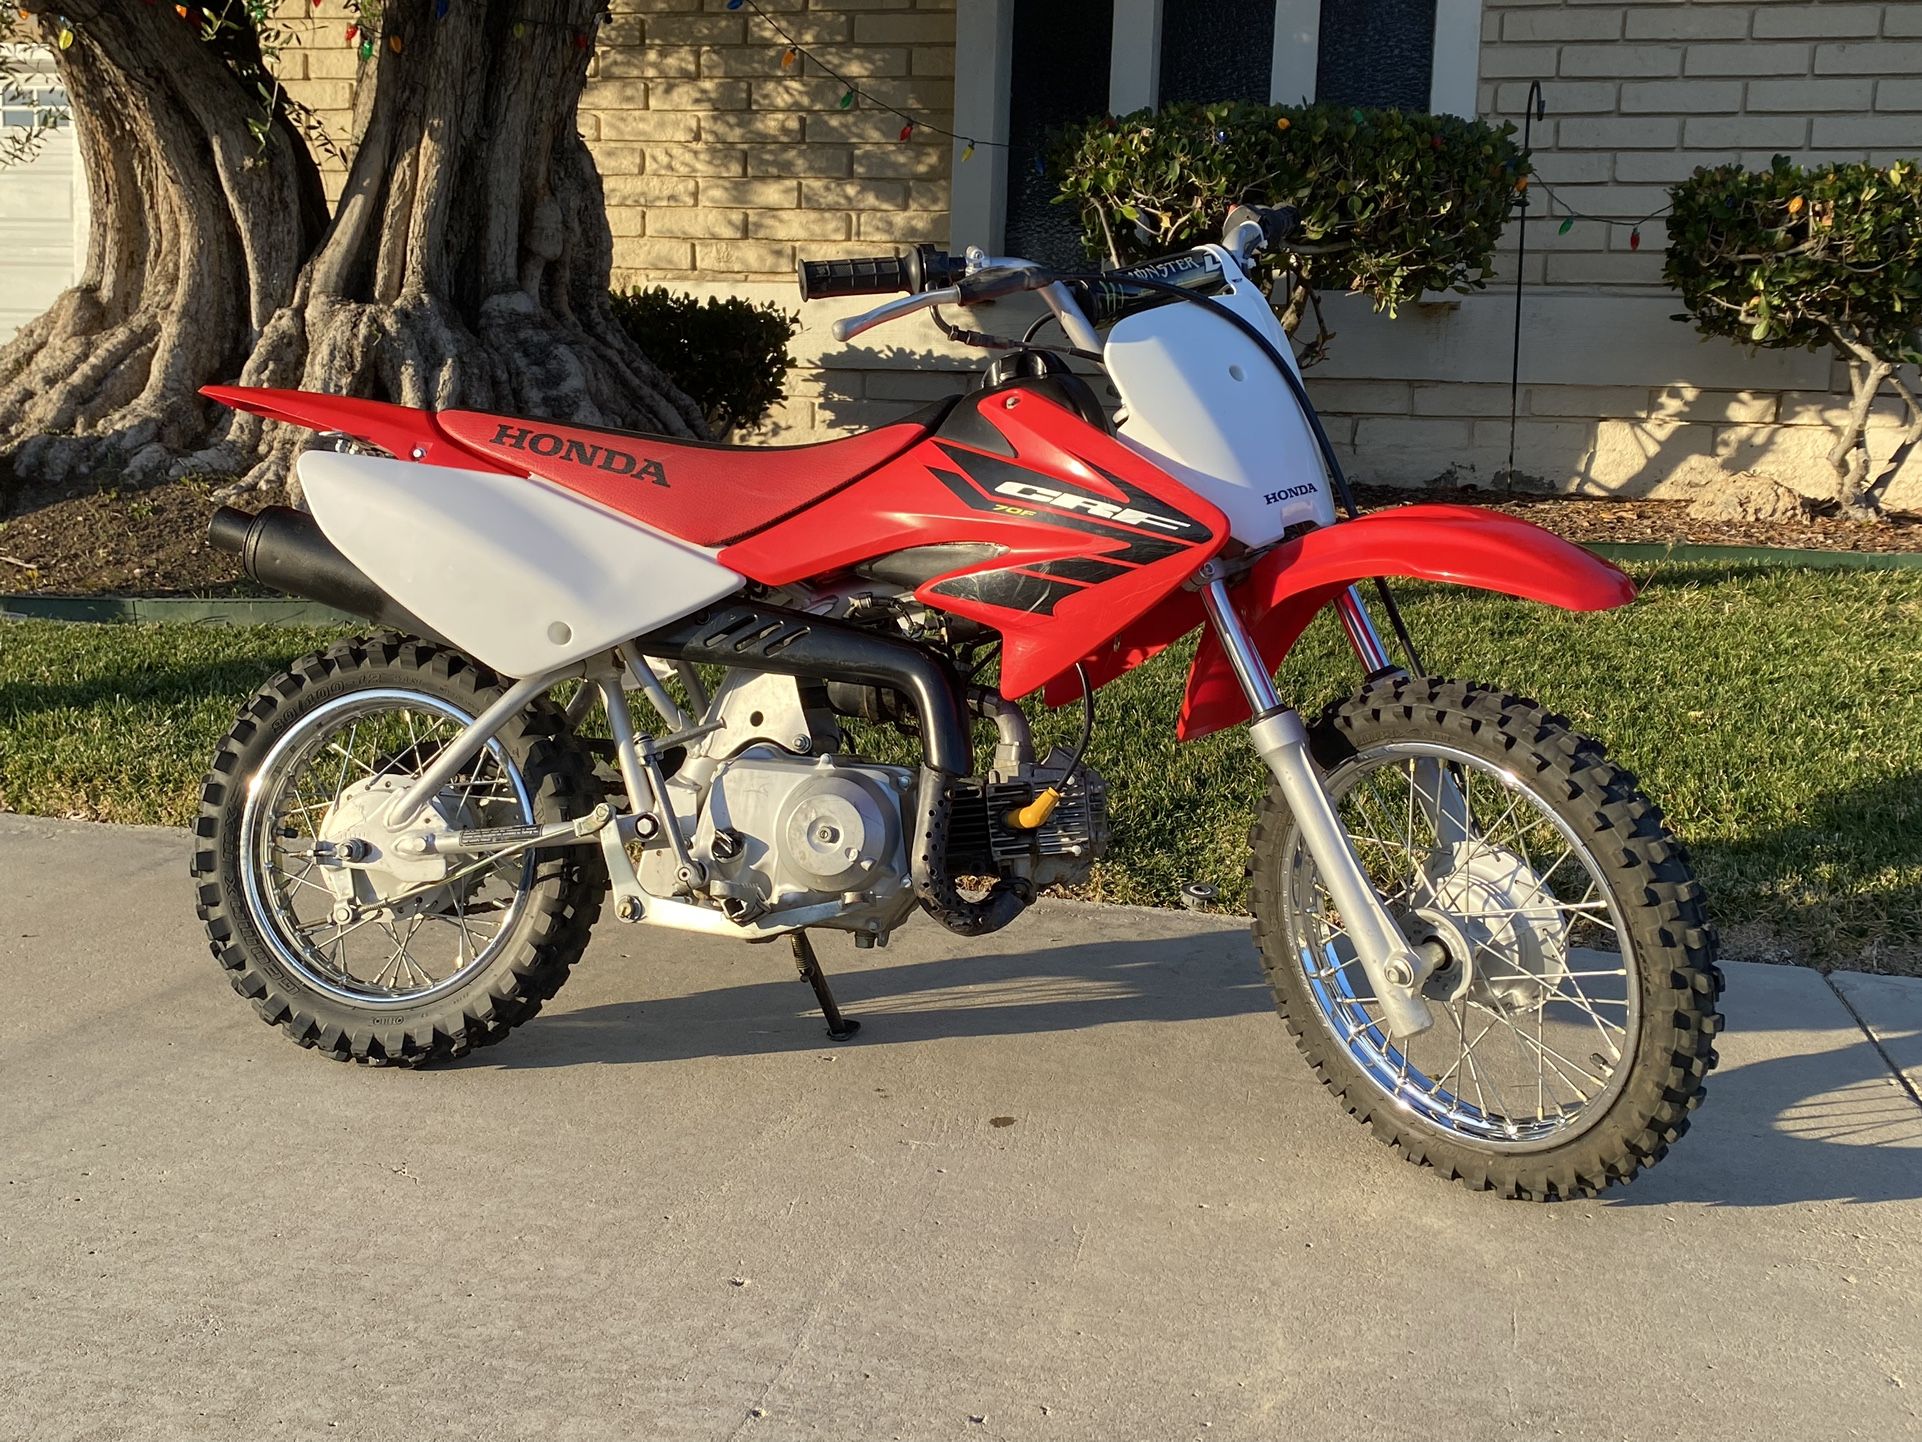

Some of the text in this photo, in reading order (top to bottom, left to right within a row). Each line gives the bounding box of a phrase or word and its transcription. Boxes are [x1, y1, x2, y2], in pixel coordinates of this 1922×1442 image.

[489, 424, 671, 487] HONDA
[993, 504, 1037, 516] 70F
[994, 481, 1191, 530] CRF
[1263, 483, 1318, 505] HONDA
